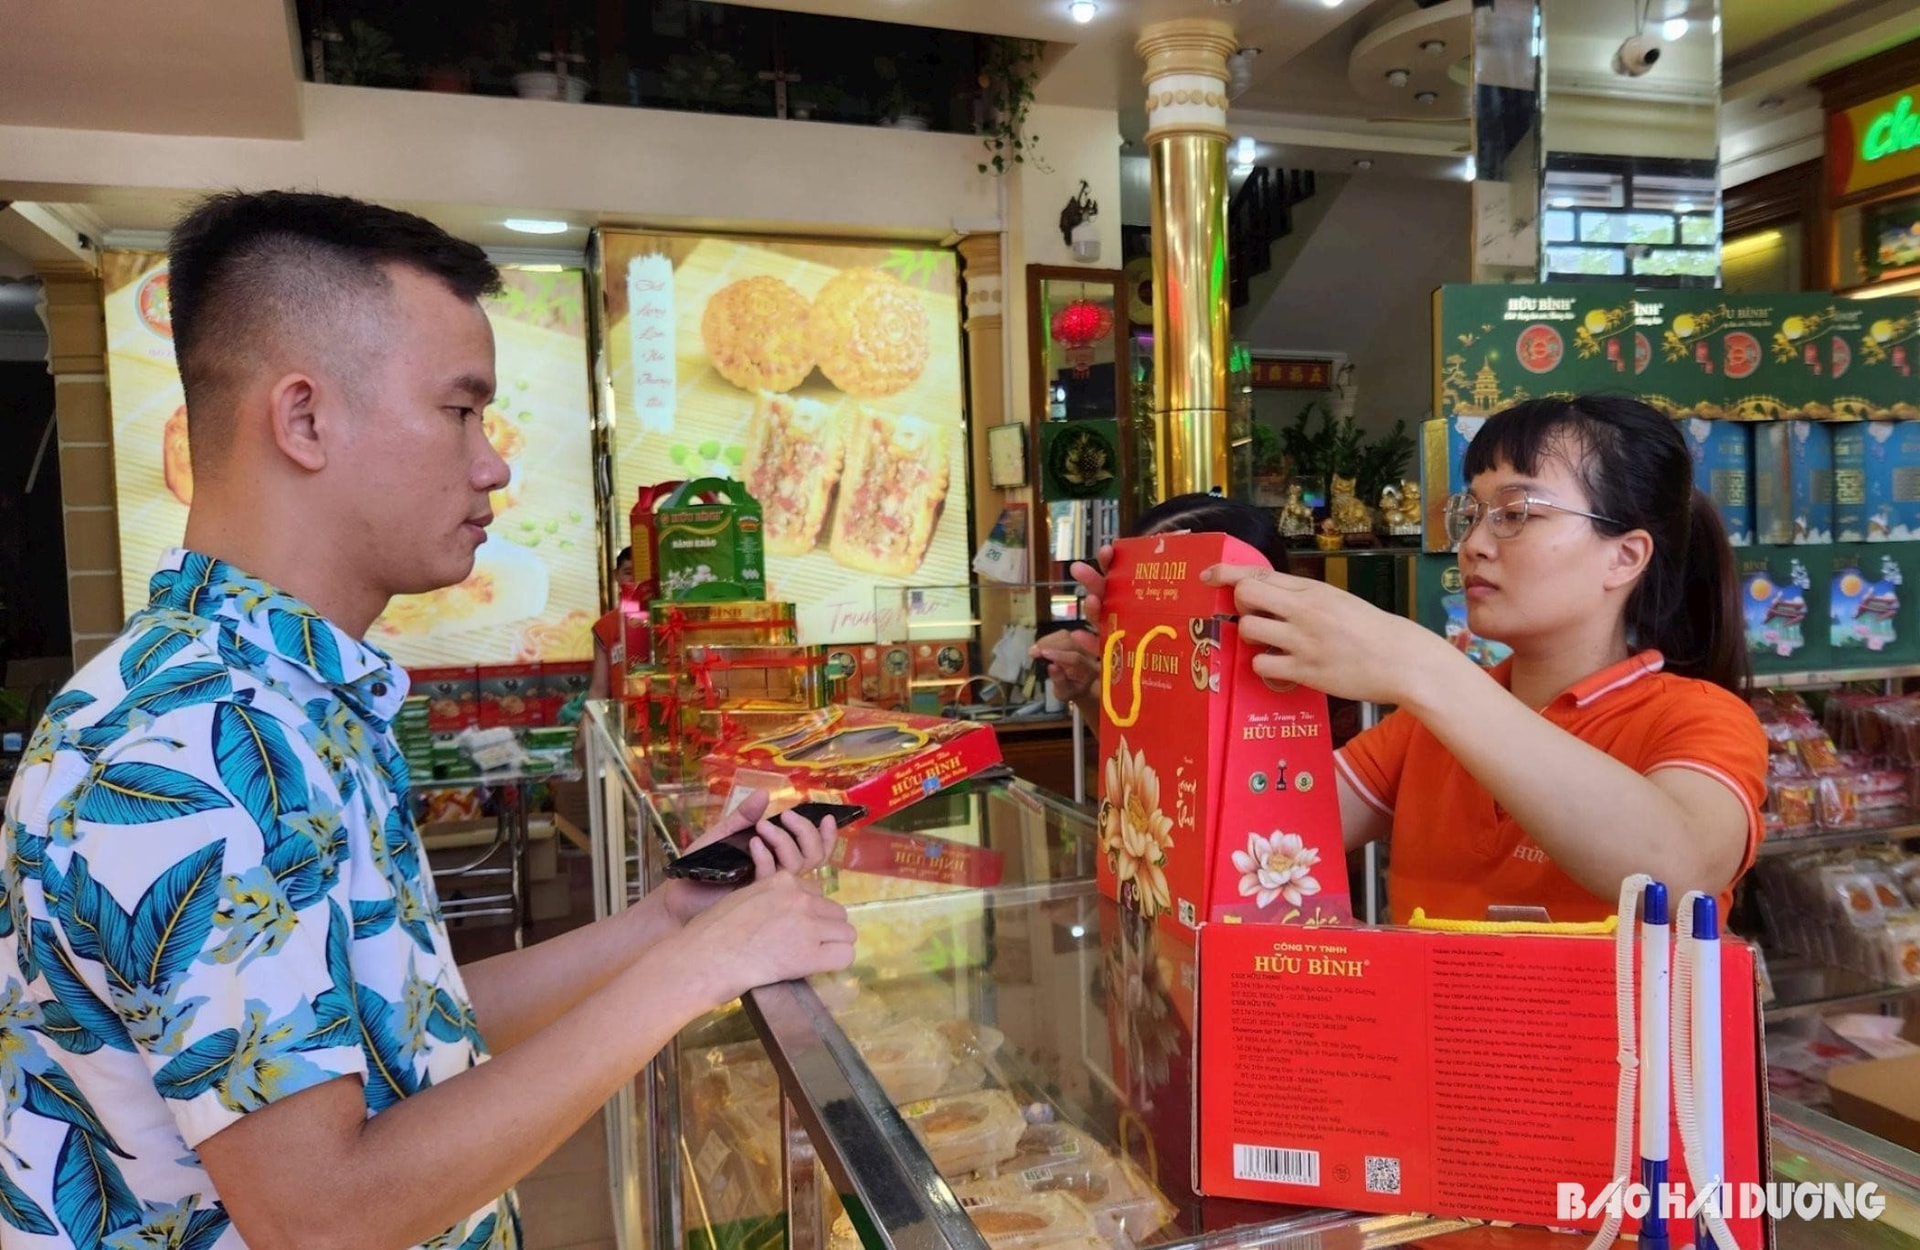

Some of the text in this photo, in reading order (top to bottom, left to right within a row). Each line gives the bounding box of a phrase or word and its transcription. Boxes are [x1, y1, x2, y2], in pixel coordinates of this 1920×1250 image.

[1134, 561, 1187, 585] HỮU BÌNH
[1127, 649, 1179, 675] HU BÌNH
[1243, 721, 1319, 740] HỮU BÌNH
[891, 773, 923, 796] HỮU
[1273, 941, 1347, 954] CÔNG TY TNHH
[1254, 953, 1363, 977] HỮU BÌNH
